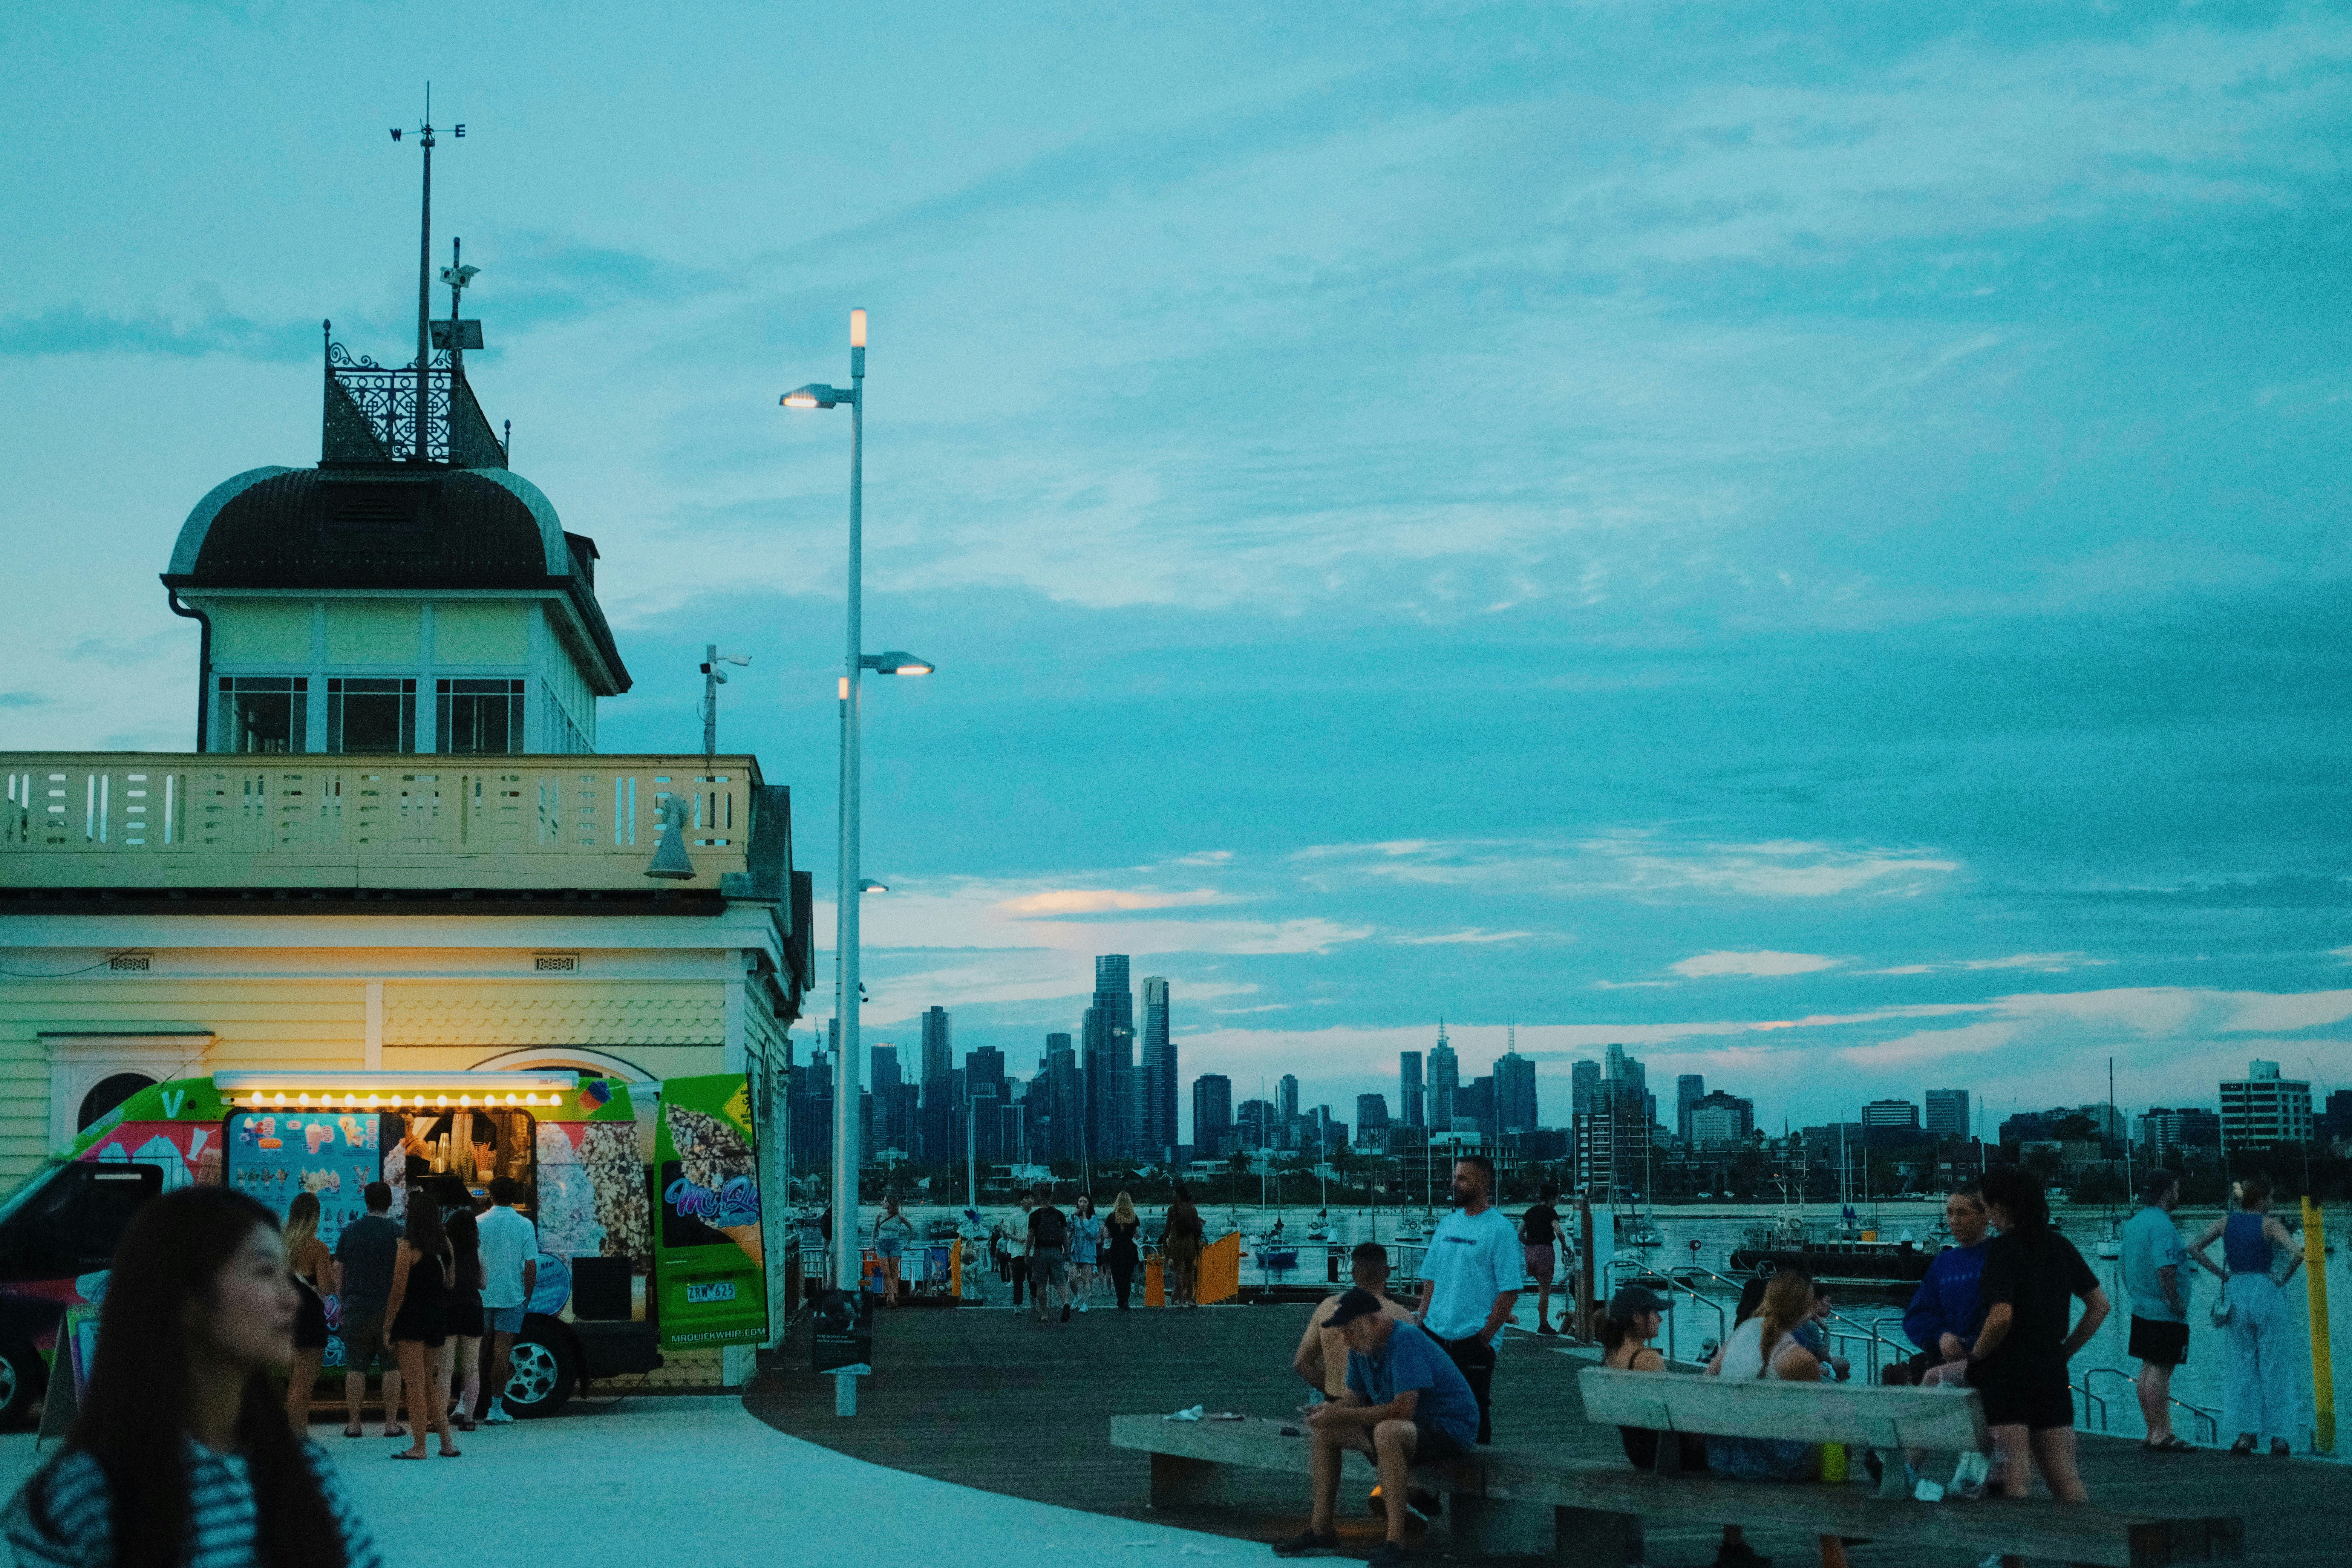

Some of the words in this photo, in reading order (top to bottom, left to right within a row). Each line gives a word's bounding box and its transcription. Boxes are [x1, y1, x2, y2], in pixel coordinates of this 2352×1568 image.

[390, 129, 401, 141] W
[455, 124, 465, 137] E
[161, 1090, 184, 1118] V
[665, 1178, 718, 1217] Mr
[689, 1286, 707, 1298] ZRW
[715, 1285, 733, 1296] 625
[671, 1328, 766, 1342] MRQUICKWHIP.COM
